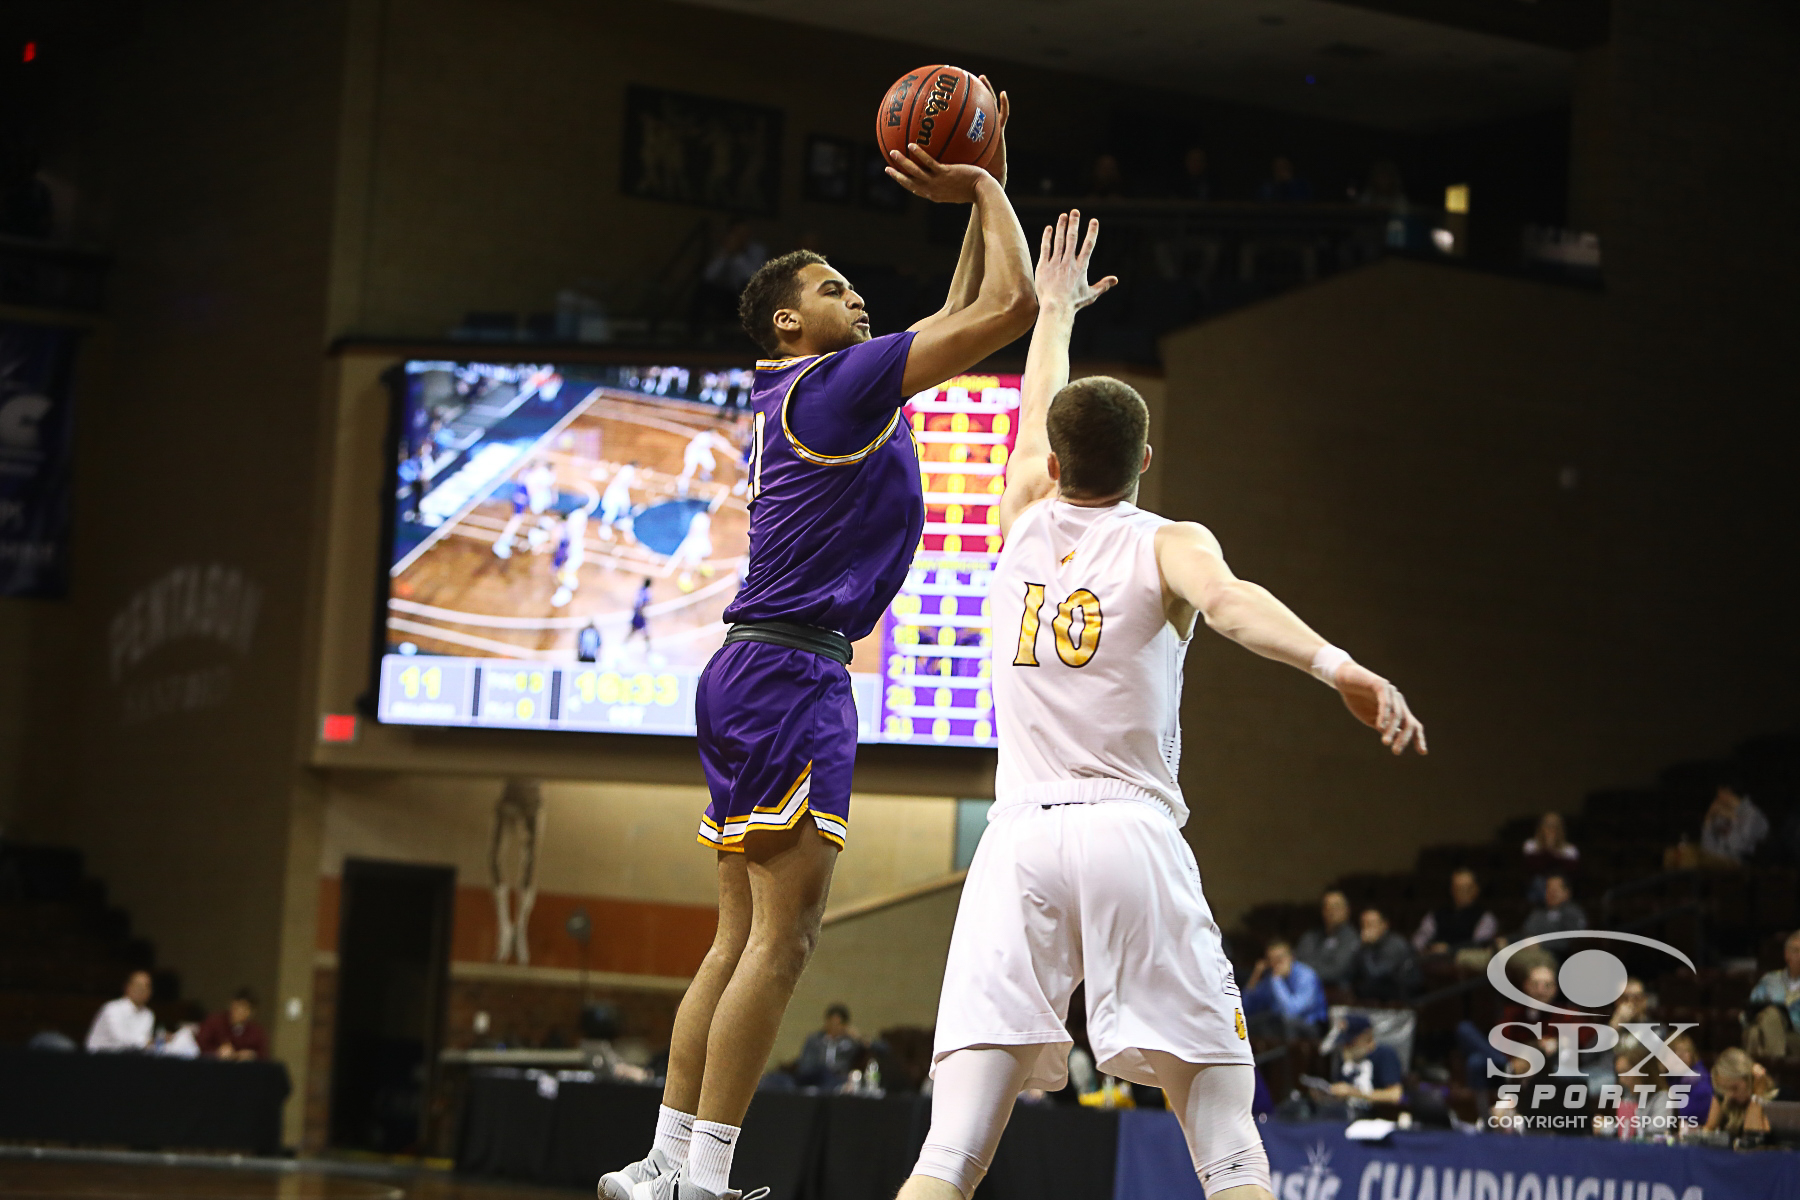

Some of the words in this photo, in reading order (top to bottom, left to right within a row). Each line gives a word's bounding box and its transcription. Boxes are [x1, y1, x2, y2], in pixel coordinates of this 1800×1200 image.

[887, 74, 919, 127] NCAA
[916, 74, 961, 147] Wilson
[1012, 581, 1104, 668] 10
[400, 666, 441, 699] 11
[1358, 1160, 1703, 1200] CHAMPION
